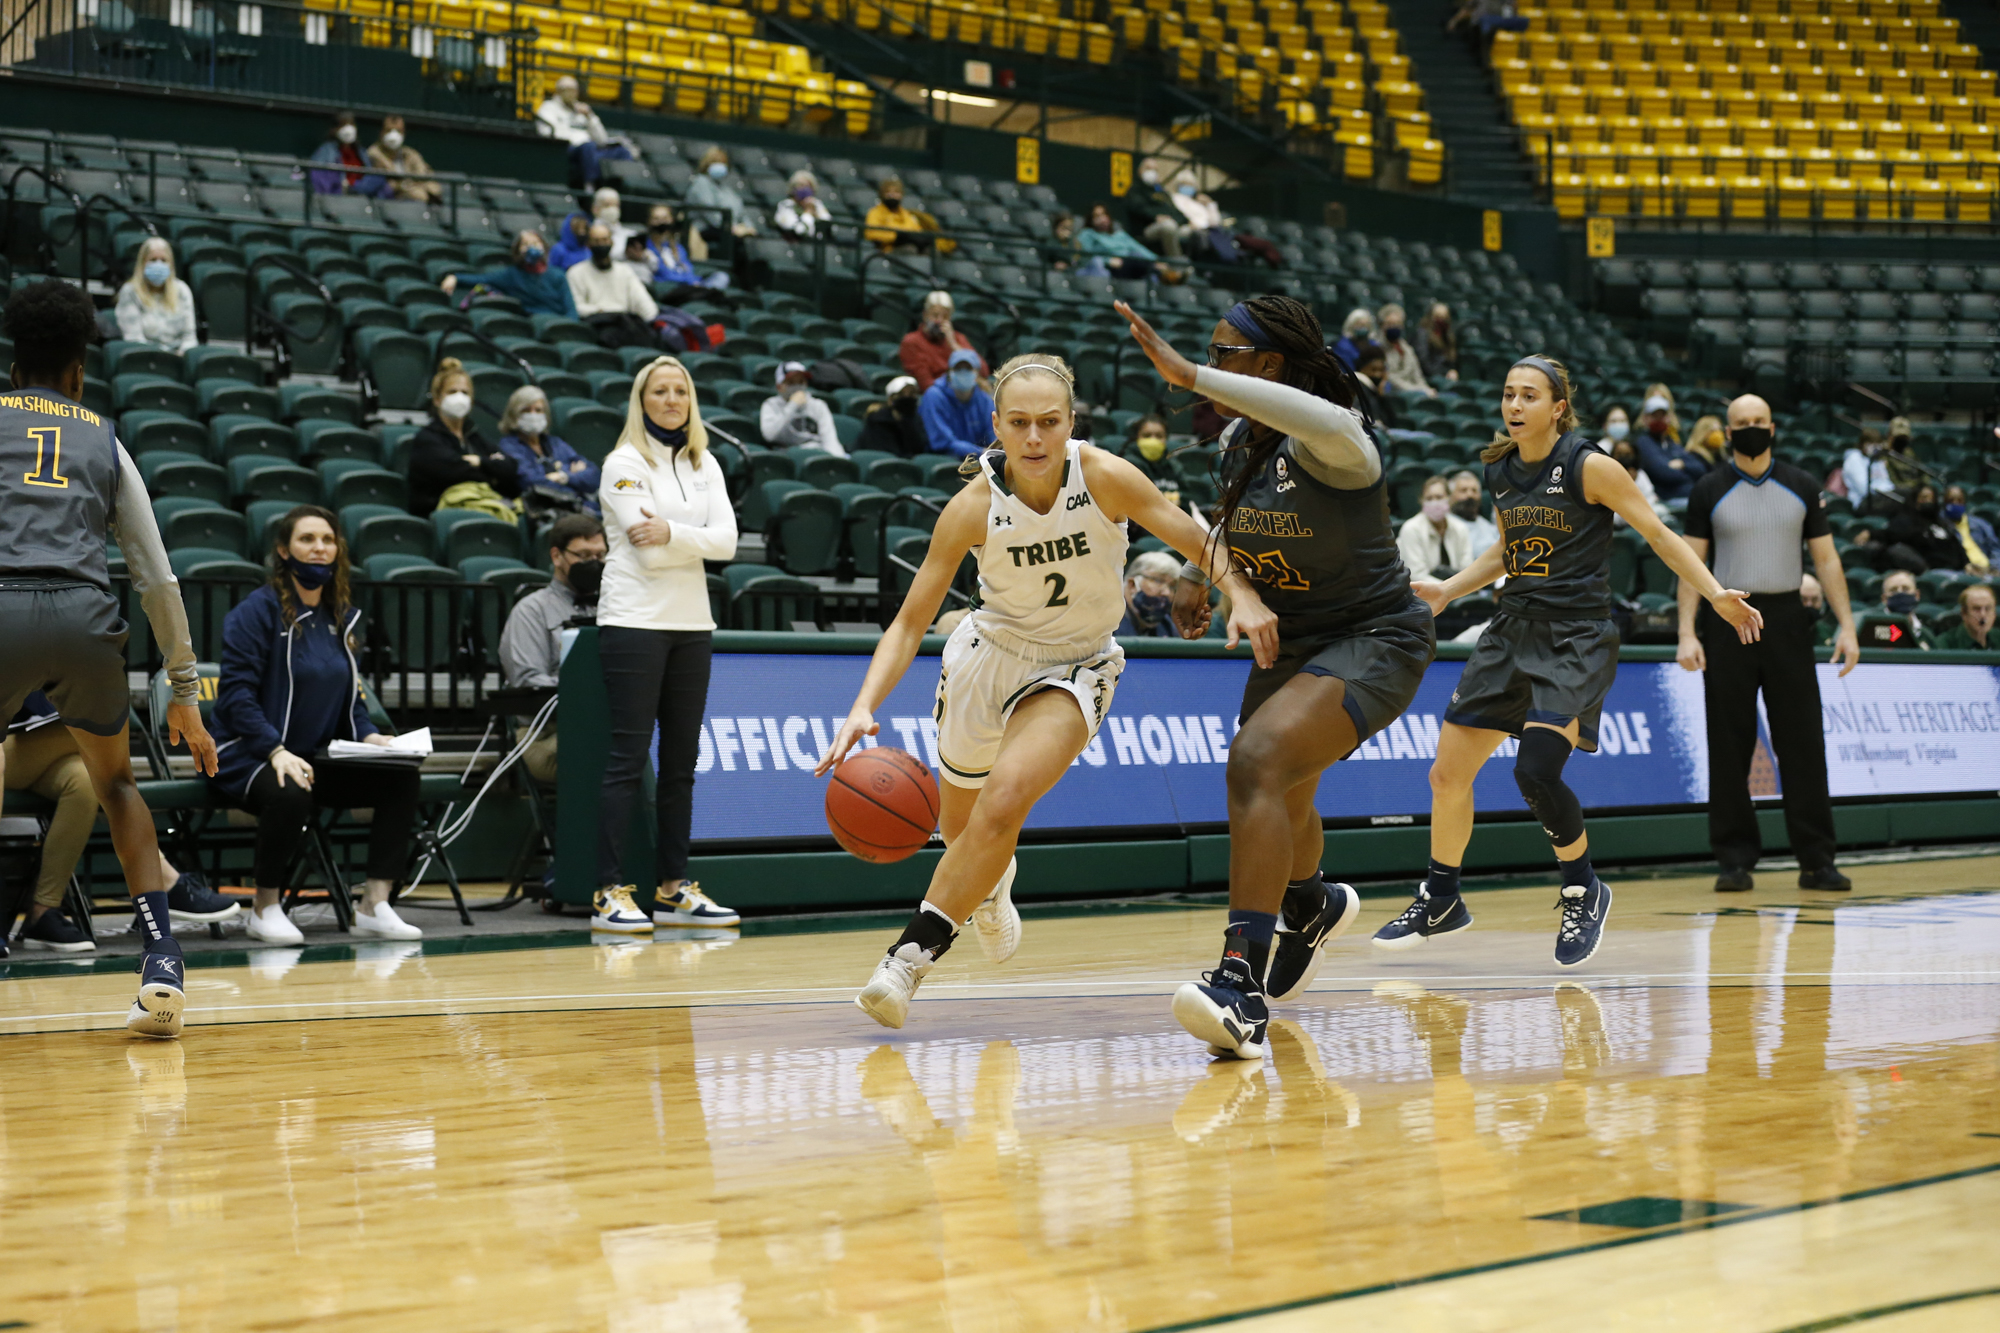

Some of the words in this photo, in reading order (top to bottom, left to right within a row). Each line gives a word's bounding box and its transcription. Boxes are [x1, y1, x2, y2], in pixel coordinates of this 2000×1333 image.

[0, 395, 100, 427] WASHINGTON
[23, 426, 69, 489] 1
[1066, 491, 1092, 511] CAA
[1276, 480, 1297, 493] CAA
[1546, 486, 1564, 495] CAA
[1229, 506, 1314, 538] EXEL
[1501, 505, 1573, 533] REXEL
[1006, 531, 1091, 567] TRIBE
[1505, 536, 1554, 578] 12
[1044, 572, 1070, 608] 2
[1893, 701, 1999, 733] HERITAGE
[1107, 714, 1230, 767] HOME
[1590, 711, 1652, 757] OLF
